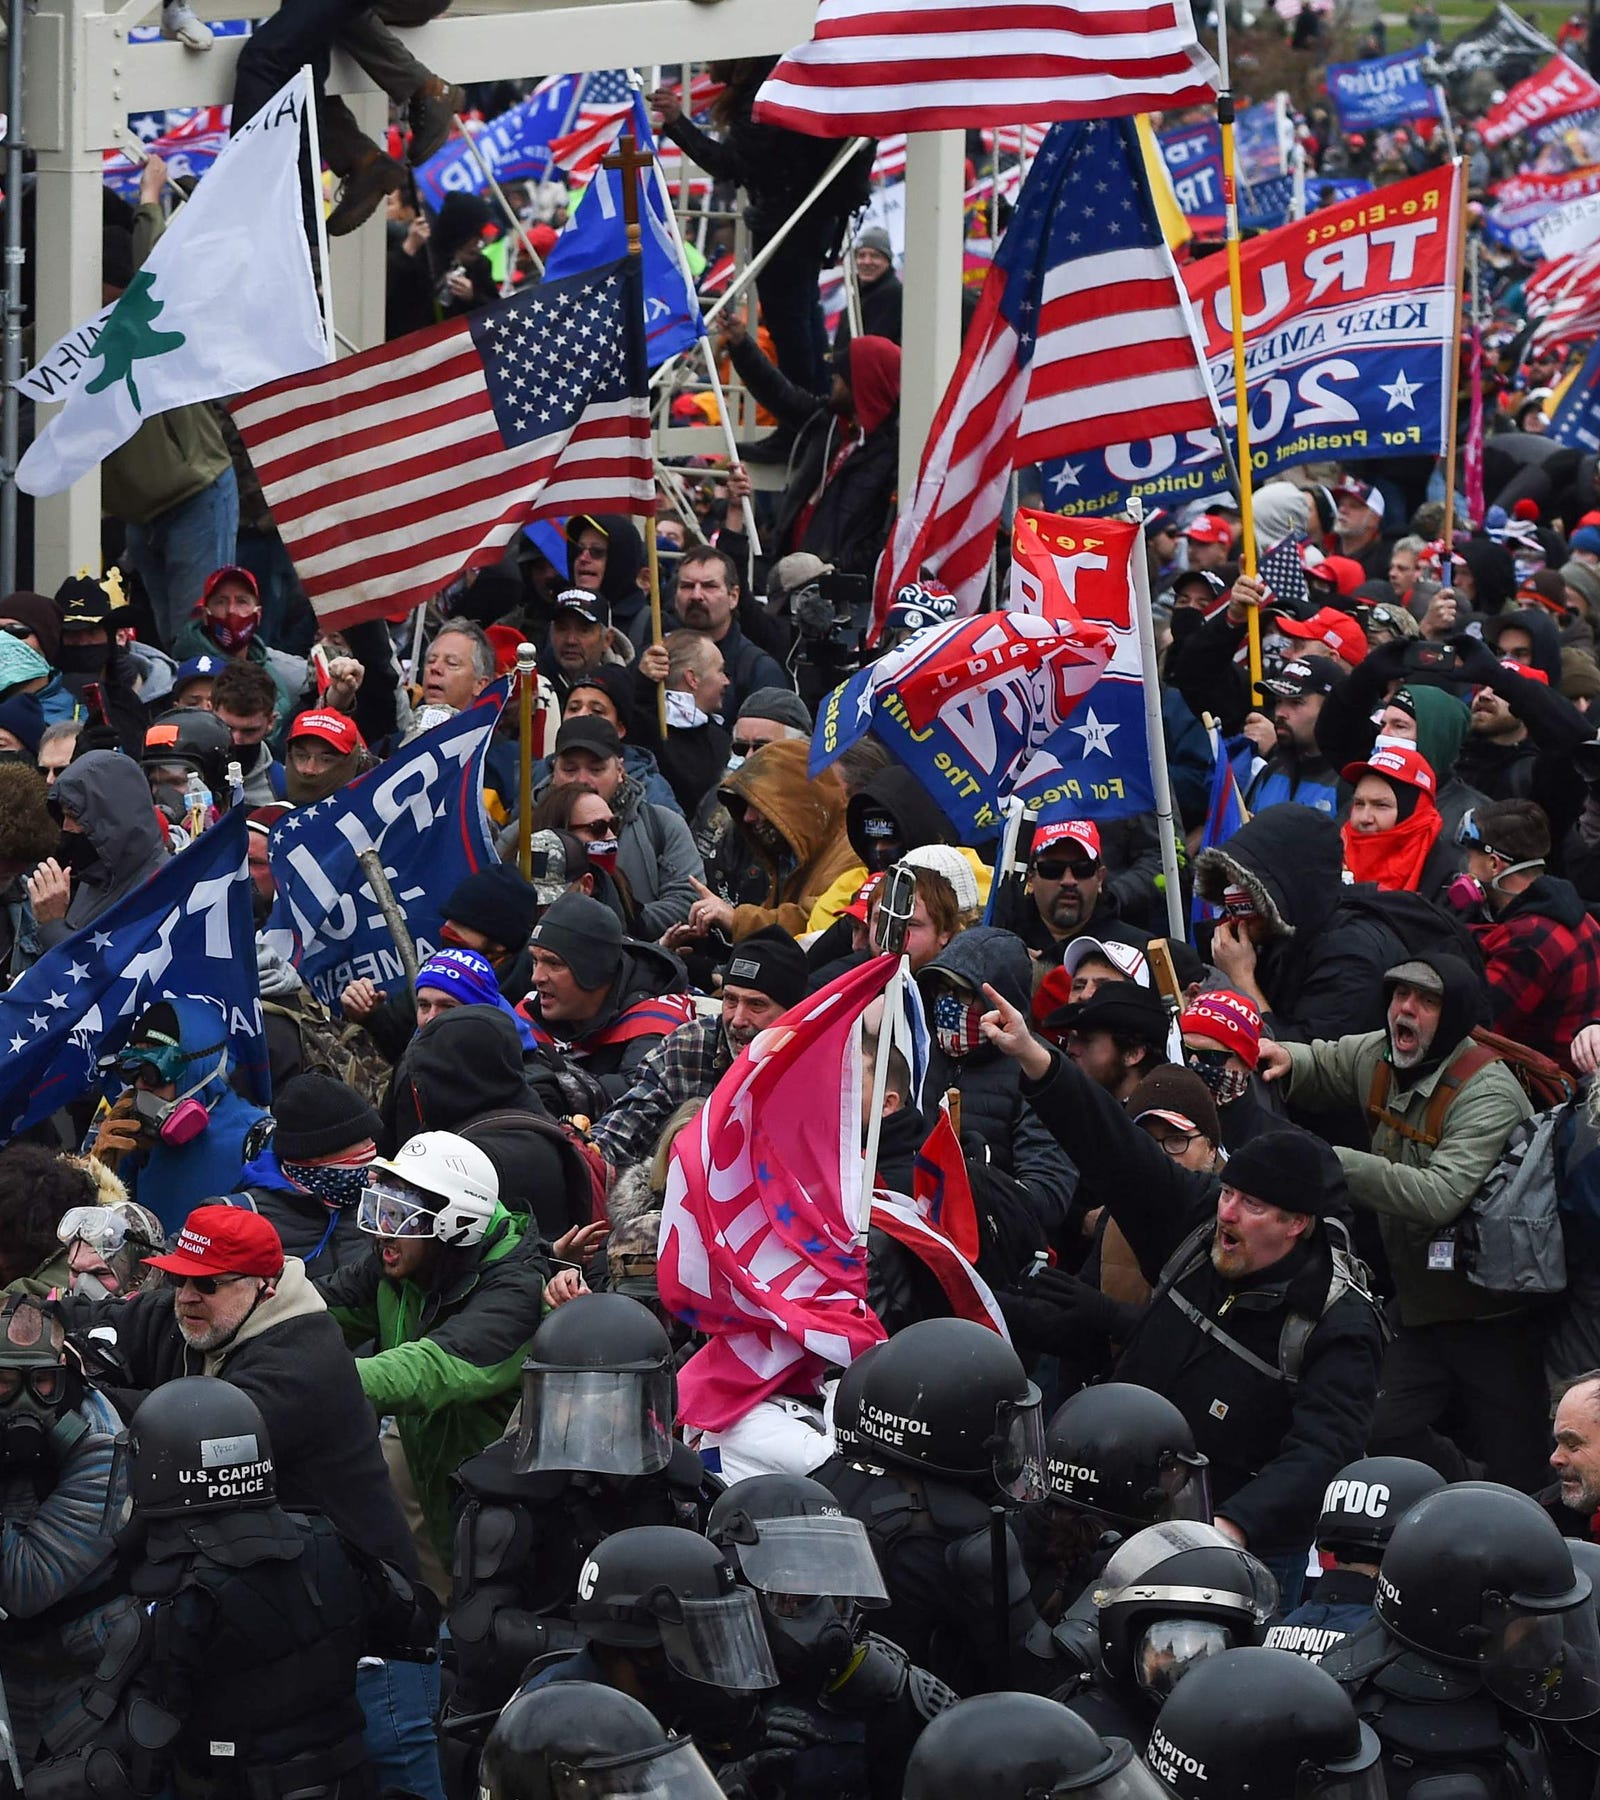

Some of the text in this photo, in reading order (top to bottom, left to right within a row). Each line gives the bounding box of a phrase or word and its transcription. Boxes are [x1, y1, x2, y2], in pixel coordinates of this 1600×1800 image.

[557, 589, 597, 602] TRUMP
[436, 948, 489, 973] UMP
[1185, 1007, 1239, 1033] 2020
[1194, 991, 1260, 1027] RUMP
[835, 1427, 859, 1444] ITOL
[859, 1416, 904, 1447] POLICE
[868, 1407, 932, 1437] CAPITOL
[178, 1458, 274, 1484] U.S. CAPITOL
[1047, 1457, 1100, 1484] APITOL
[208, 1478, 264, 1498] POLICE
[1050, 1476, 1074, 1494] ICE
[1379, 1570, 1402, 1606] ITOL
[1262, 1626, 1346, 1653] METROPOLIT
[1148, 1744, 1179, 1785] OLICE
[1154, 1728, 1208, 1781] CAPITOL
